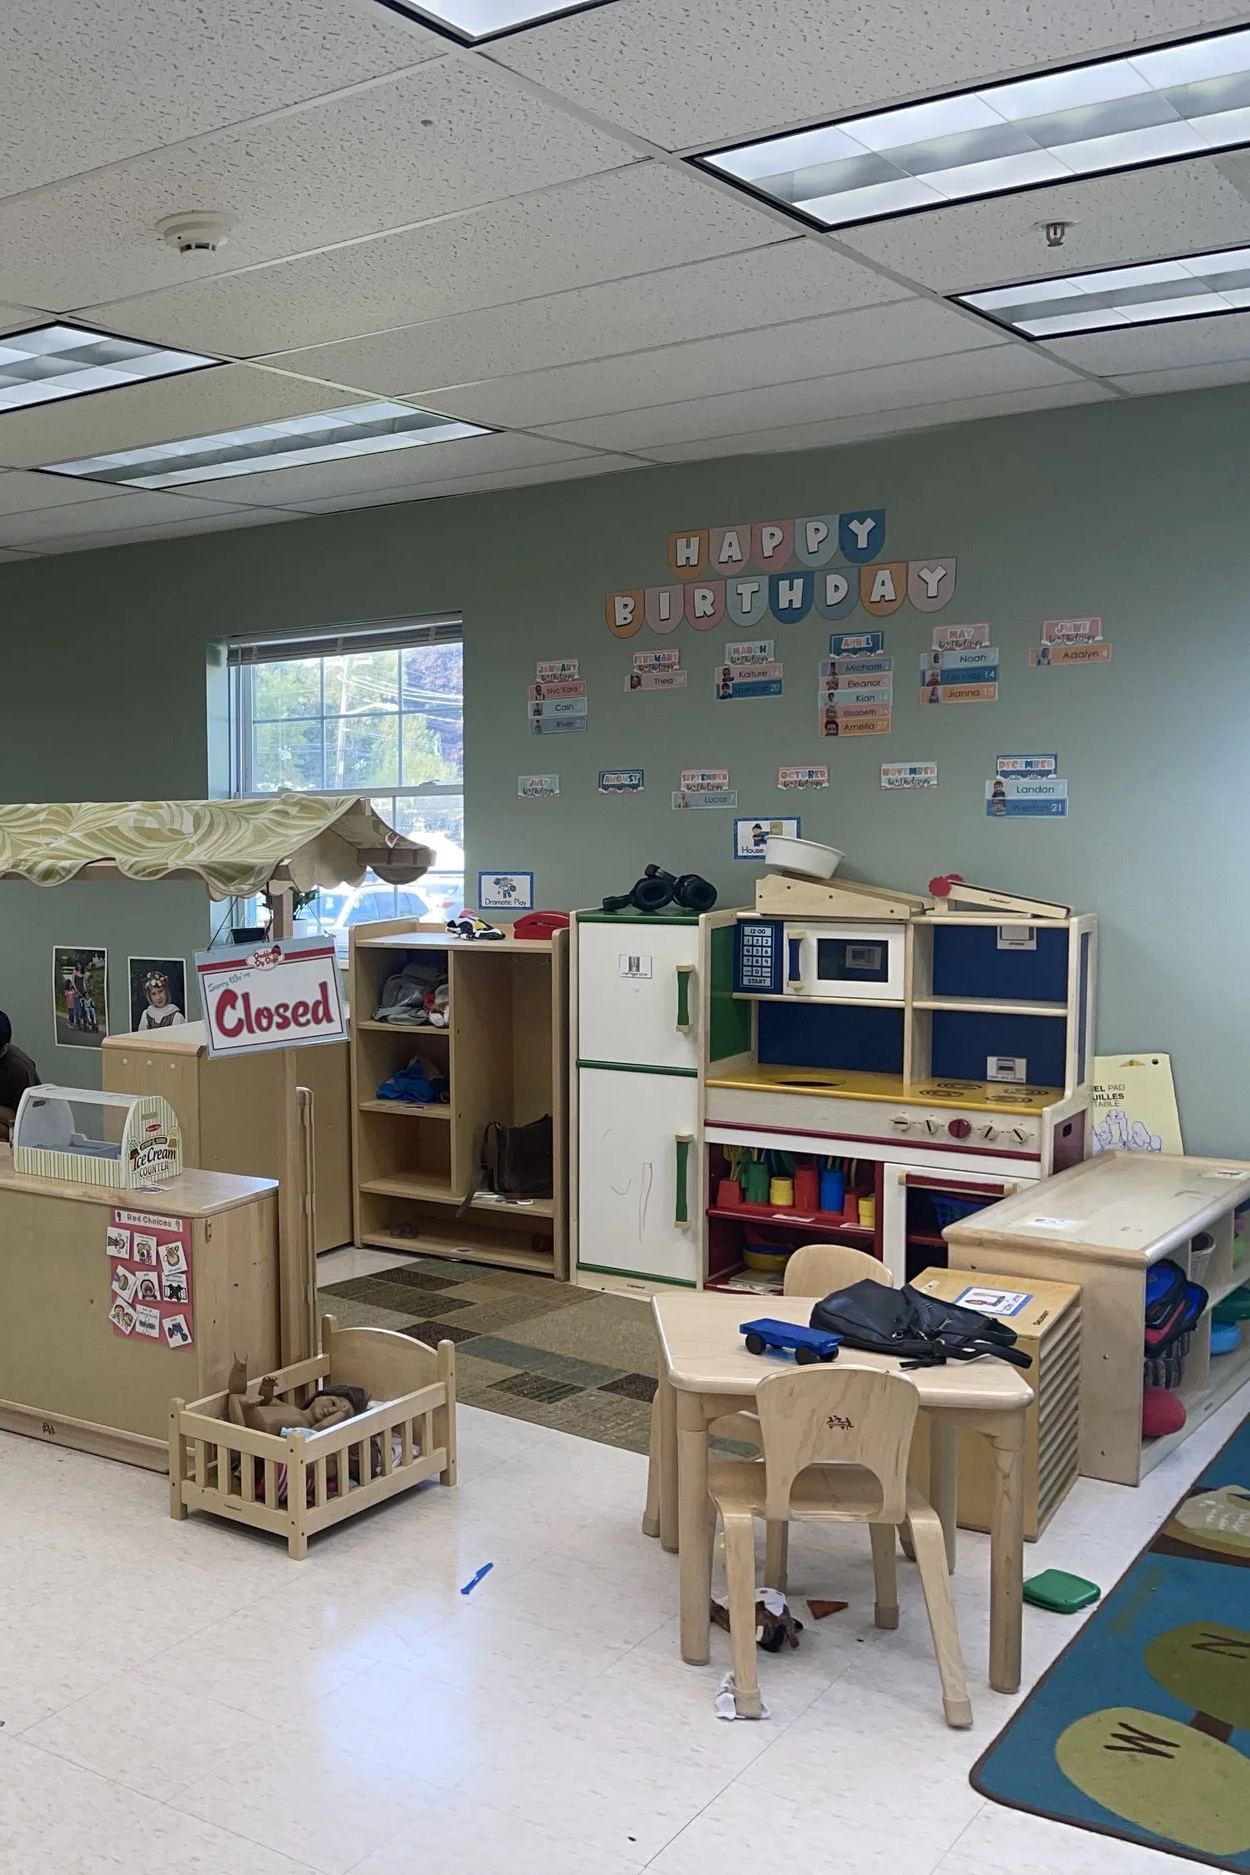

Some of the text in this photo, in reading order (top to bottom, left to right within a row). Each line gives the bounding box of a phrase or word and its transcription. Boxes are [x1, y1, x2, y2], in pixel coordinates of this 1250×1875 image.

[676, 517, 876, 567] HAPPY
[614, 565, 947, 627] BIRTHDAY
[948, 627, 974, 640] MAY
[959, 654, 987, 663] Noah
[1062, 650, 1100, 660] Adalyn
[845, 662, 882, 672] Michael
[984, 670, 995, 679] 14
[653, 676, 674, 686] Thea
[847, 679, 881, 689] Eleanor
[855, 694, 876, 703] Kian
[948, 688, 981, 699] Jianna
[554, 703, 575, 712] Cash
[843, 722, 876, 732] Amelia
[780, 769, 827, 780] OCTOBER
[1015, 785, 1055, 794] Landon
[704, 795, 728, 804] Lucas
[1051, 803, 1063, 812] 21
[741, 845, 765, 855] House
[484, 897, 527, 908] Dramatic Play
[215, 981, 335, 1038] Closed
[1107, 1083, 1126, 1092] PAD
[133, 1147, 177, 1171] Ice Cream
[139, 1161, 170, 1178] COUNTER
[126, 1213, 172, 1228] Red Choices
